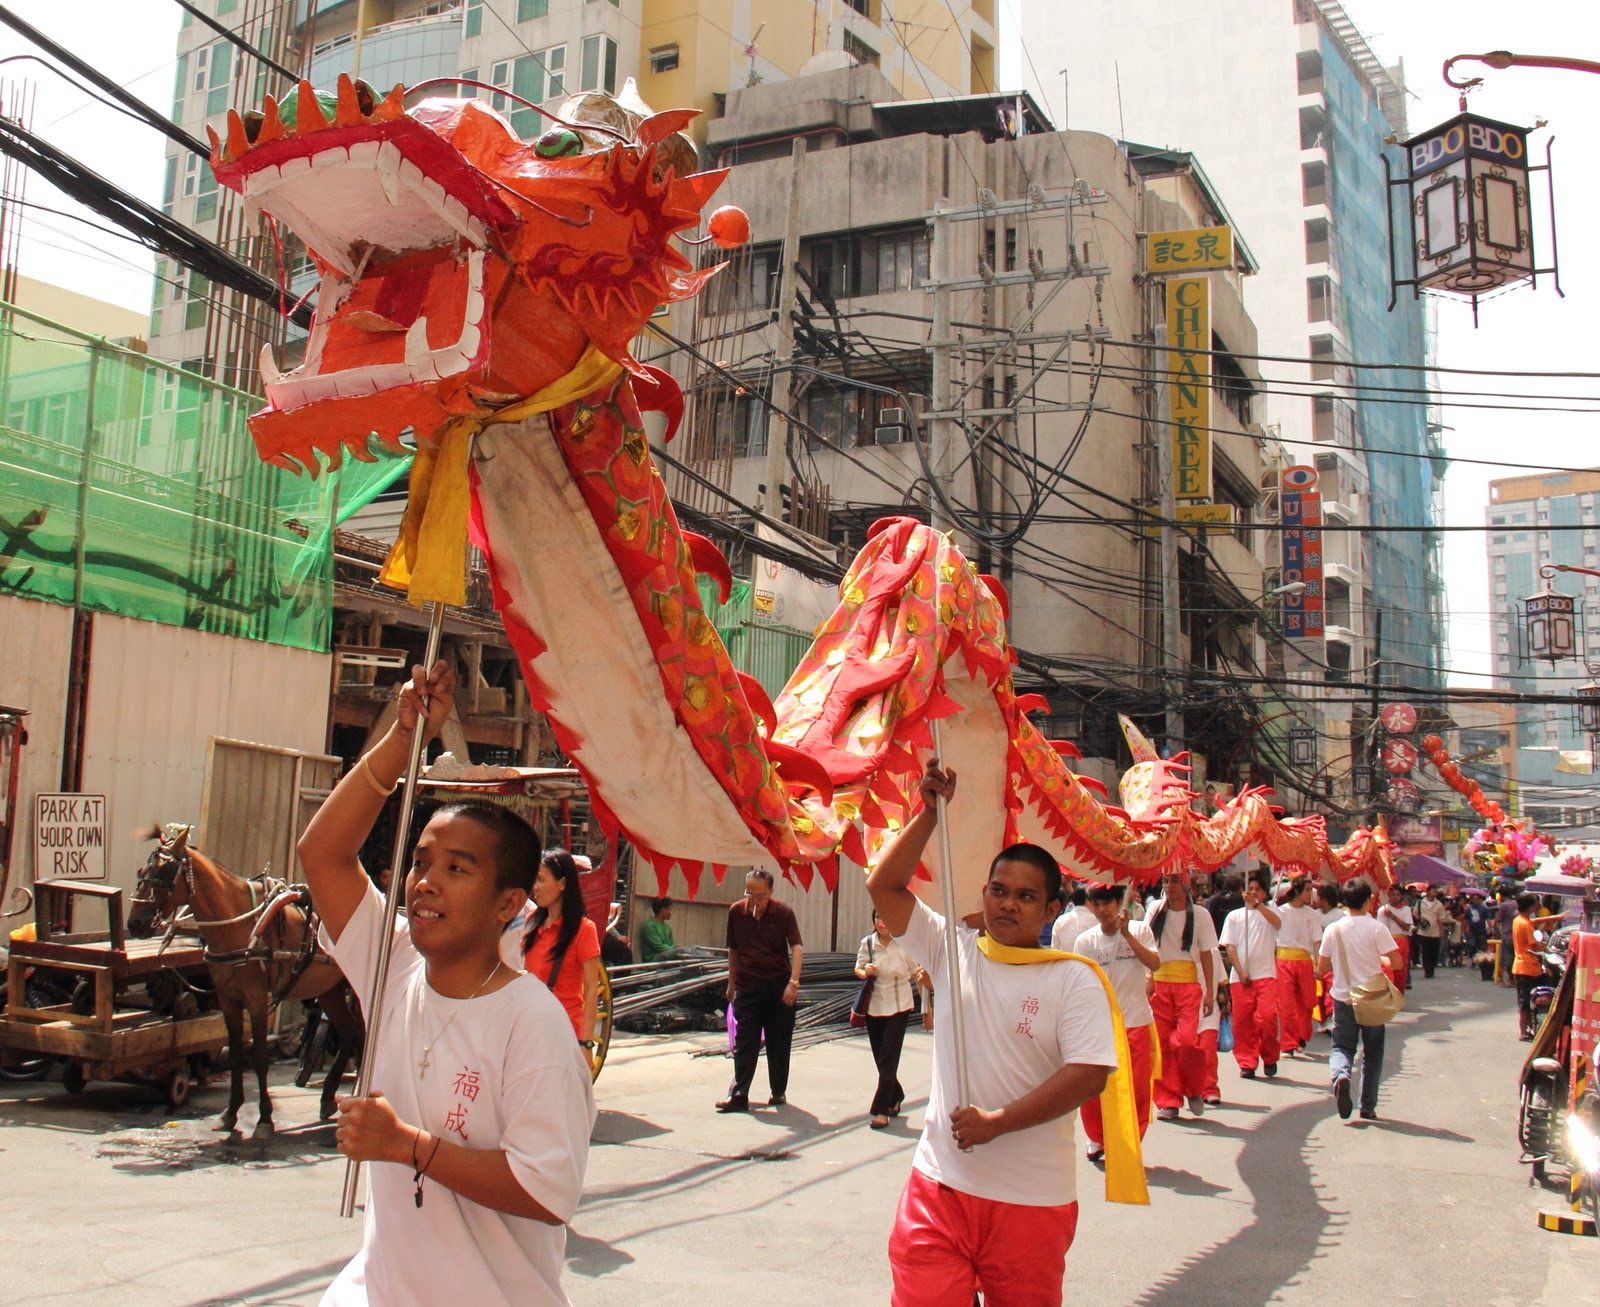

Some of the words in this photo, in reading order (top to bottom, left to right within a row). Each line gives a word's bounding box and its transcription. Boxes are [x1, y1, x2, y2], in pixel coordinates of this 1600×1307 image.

[1412, 127, 1464, 171] BDO
[1468, 123, 1523, 159] BDO
[1174, 281, 1203, 410] CHUAN
[1176, 416, 1201, 494] KEE
[1527, 599, 1548, 612] BDO
[1549, 598, 1572, 611] BDO
[40, 799, 78, 822] PARK
[82, 799, 102, 822] AT
[40, 827, 74, 847] YOUR
[77, 827, 102, 847] OWN
[54, 851, 88, 874] RISK
[1015, 995, 1039, 1039] 福成
[444, 1065, 480, 1141] 福成
